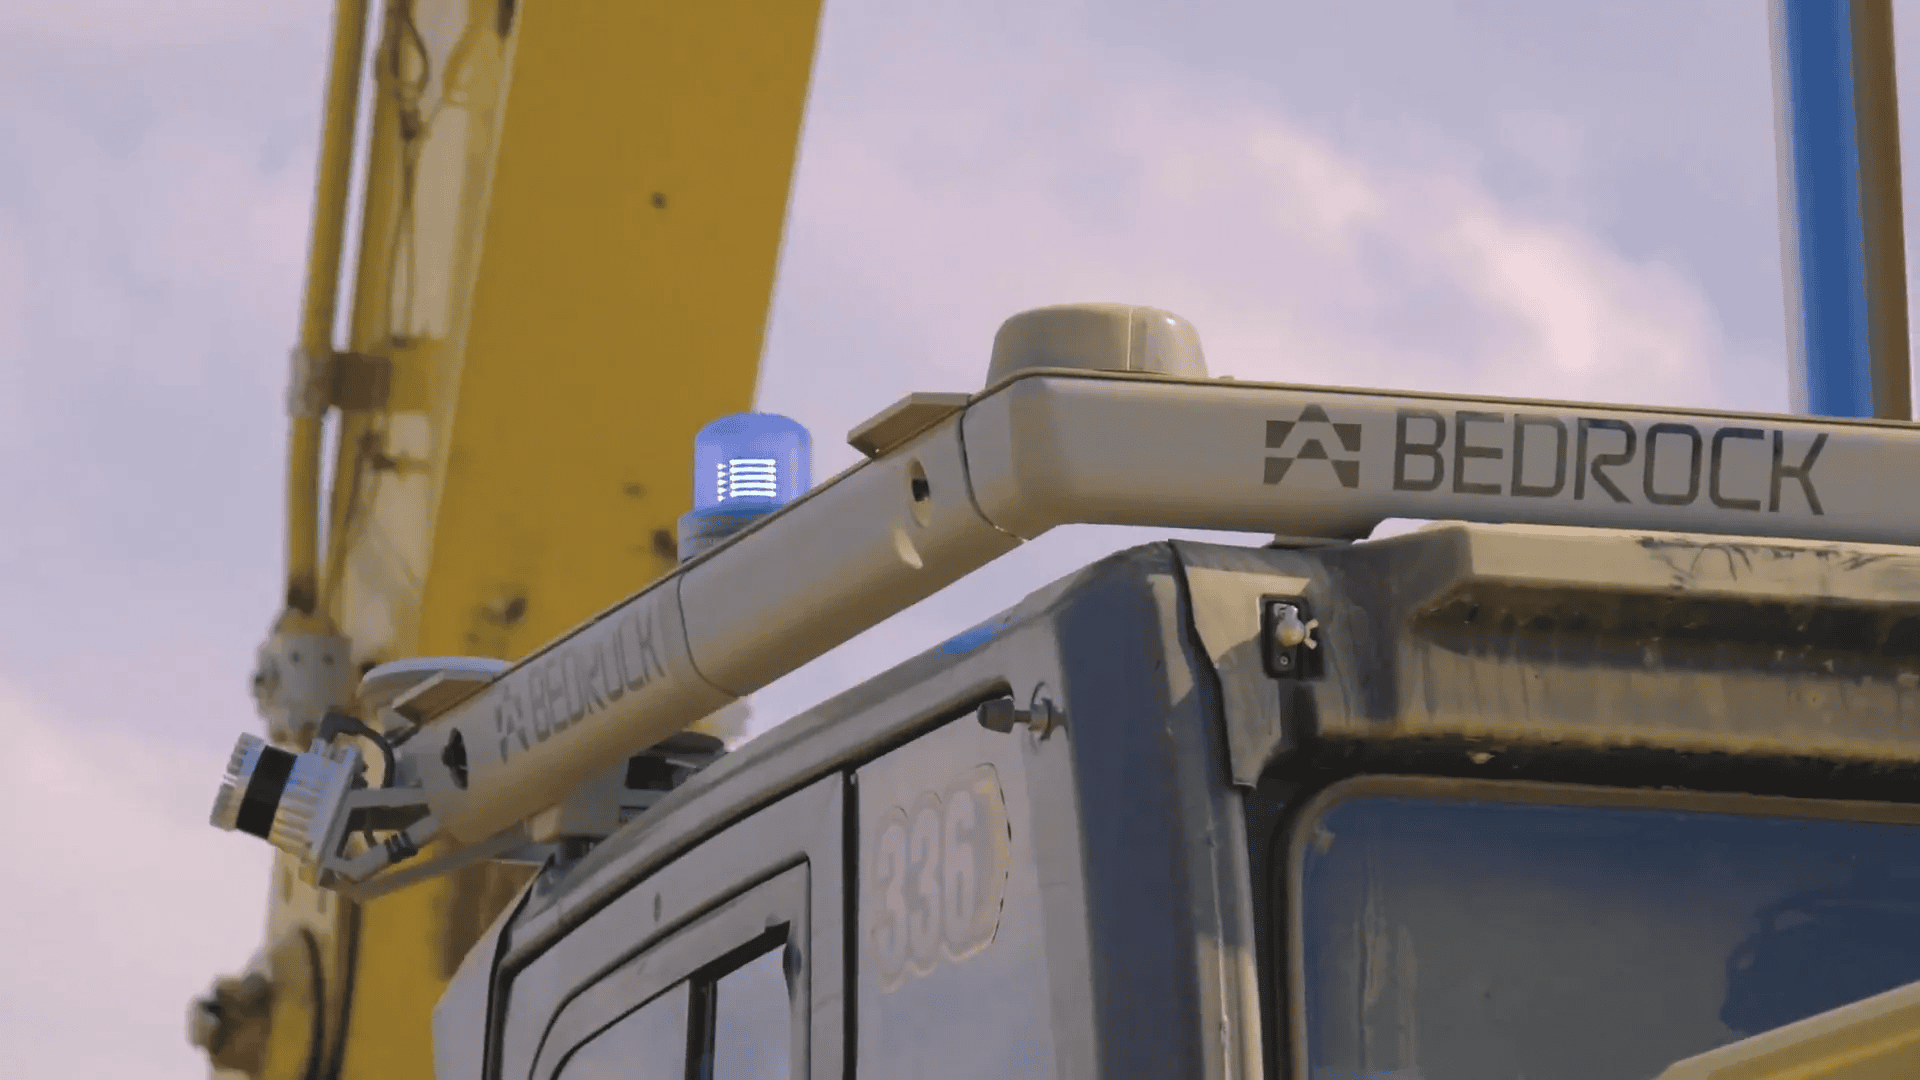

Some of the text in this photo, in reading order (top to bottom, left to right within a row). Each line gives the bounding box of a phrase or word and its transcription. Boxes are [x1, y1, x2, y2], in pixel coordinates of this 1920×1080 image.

[1392, 409, 1829, 515] BEDROCK
[528, 609, 666, 744] BEDROCK
[869, 785, 979, 975] 336
